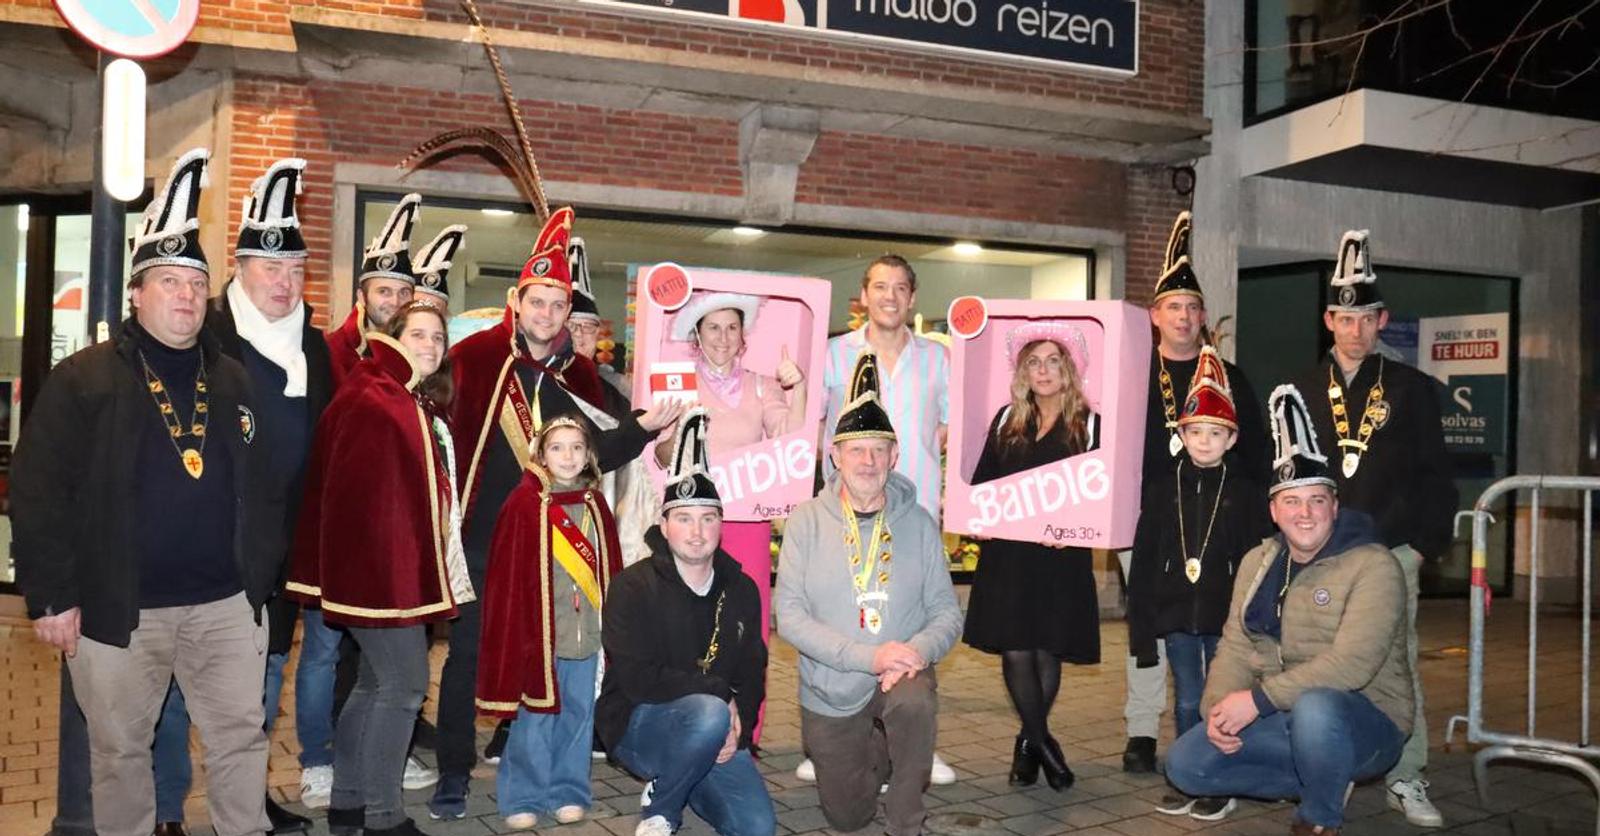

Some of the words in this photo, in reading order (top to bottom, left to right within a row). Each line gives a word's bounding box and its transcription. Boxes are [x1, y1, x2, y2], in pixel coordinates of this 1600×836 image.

[998, 2, 1114, 48] reizen
[1435, 345, 1452, 358] TE
[1454, 343, 1495, 358] HUUR
[1441, 412, 1486, 428] solvas
[709, 439, 816, 504] arbie
[967, 458, 1110, 533] Barbie
[752, 503, 783, 518] Ages
[1044, 524, 1076, 540] Ages
[1078, 527, 1103, 540] 30+
